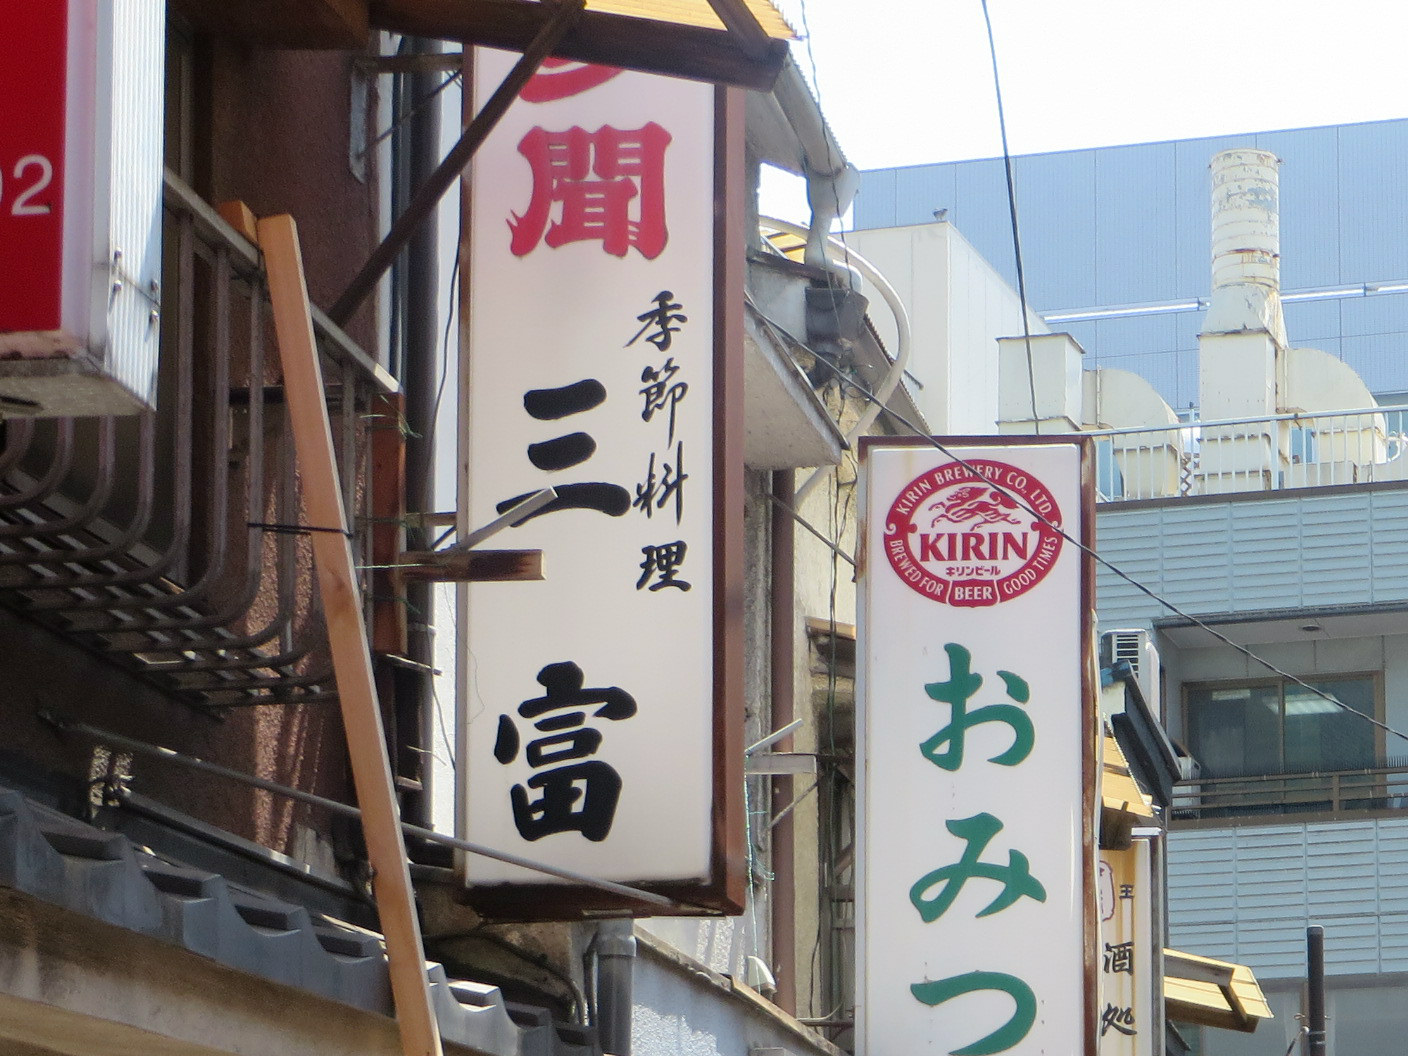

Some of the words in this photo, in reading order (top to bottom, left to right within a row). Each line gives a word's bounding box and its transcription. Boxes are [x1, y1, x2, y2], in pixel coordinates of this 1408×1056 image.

[0, 152, 53, 216] 2
[626, 289, 692, 595] 季節料理
[896, 479, 933, 516] KIRIN
[935, 464, 1003, 486] BREWERY
[889, 539, 921, 583] BREWED
[918, 577, 945, 597] FOR
[1002, 568, 1037, 596] GOOD
[1033, 536, 1058, 573] TIMES
[919, 531, 1029, 562] KIRIN
[945, 565, 1001, 577] キリンビール
[493, 378, 639, 843] 三富
[954, 586, 993, 600] BEER
[1101, 942, 1138, 1037] 酒処
